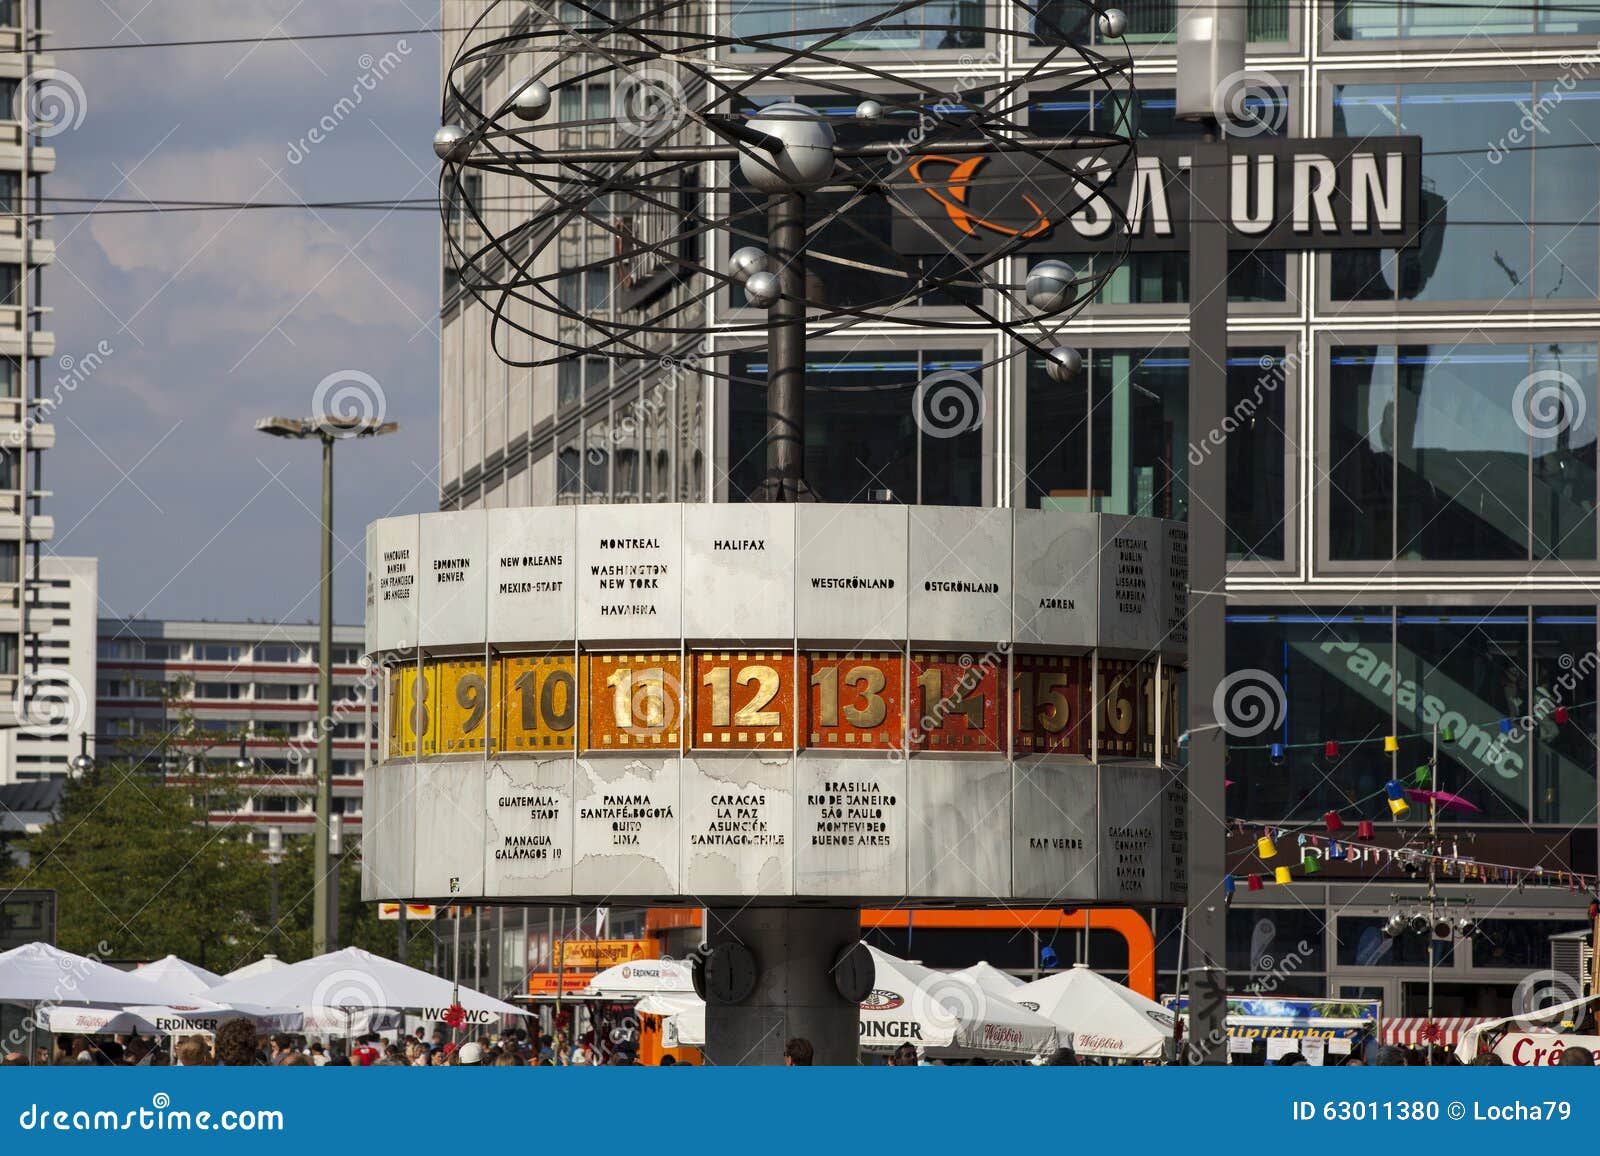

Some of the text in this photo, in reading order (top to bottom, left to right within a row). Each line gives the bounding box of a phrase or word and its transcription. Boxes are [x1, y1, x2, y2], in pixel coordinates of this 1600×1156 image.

[1071, 151, 1404, 238] SAURN
[600, 538, 660, 549] MONTREAL
[714, 540, 765, 550] HALIFAX
[500, 555, 563, 567] NEW ORLEANS
[1120, 551, 1143, 562] DUBLIN
[433, 558, 470, 570] EDMONTON
[591, 564, 667, 576] WASHINGTON
[1118, 565, 1143, 576] LONDON
[437, 571, 464, 583] DENVER
[811, 576, 895, 589] WESTGRÖNLAND
[499, 581, 563, 594] MEXIKO-STADT
[600, 578, 658, 589] NEW YORK
[924, 580, 999, 593] OSTGRÖNLAND
[1039, 598, 1075, 610] AZOREN
[515, 670, 576, 731] 10
[606, 668, 664, 728] 11
[703, 666, 780, 726] 12
[811, 666, 886, 727] 13
[917, 669, 984, 729] 14
[1013, 672, 1070, 732] 15
[456, 673, 487, 733] 9
[825, 781, 880, 793] BRASILIA
[603, 795, 651, 806] PANAMA
[711, 795, 765, 806] CARACAS
[807, 794, 896, 806] RIO DE JANEIRO
[531, 809, 559, 819] STADT
[717, 808, 758, 818] LA PAZ
[821, 805, 882, 819] SÃO PAULO
[612, 821, 642, 831] QUITO
[709, 819, 767, 831] ASUNCIÓN
[817, 821, 886, 833] MONTEVIDEO
[505, 835, 552, 846] MANAGUA
[812, 835, 890, 846] BUENOS AIRES
[1052, 838, 1083, 849] VERDE
[495, 847, 547, 859] GALÁPAGOS
[464, 1010, 490, 1023] WC
[156, 1017, 218, 1031] ERDINGER
[859, 1020, 924, 1041] DINGER
[1227, 1025, 1336, 1039] aipirinha
[1079, 1033, 1125, 1050] Weißbier
